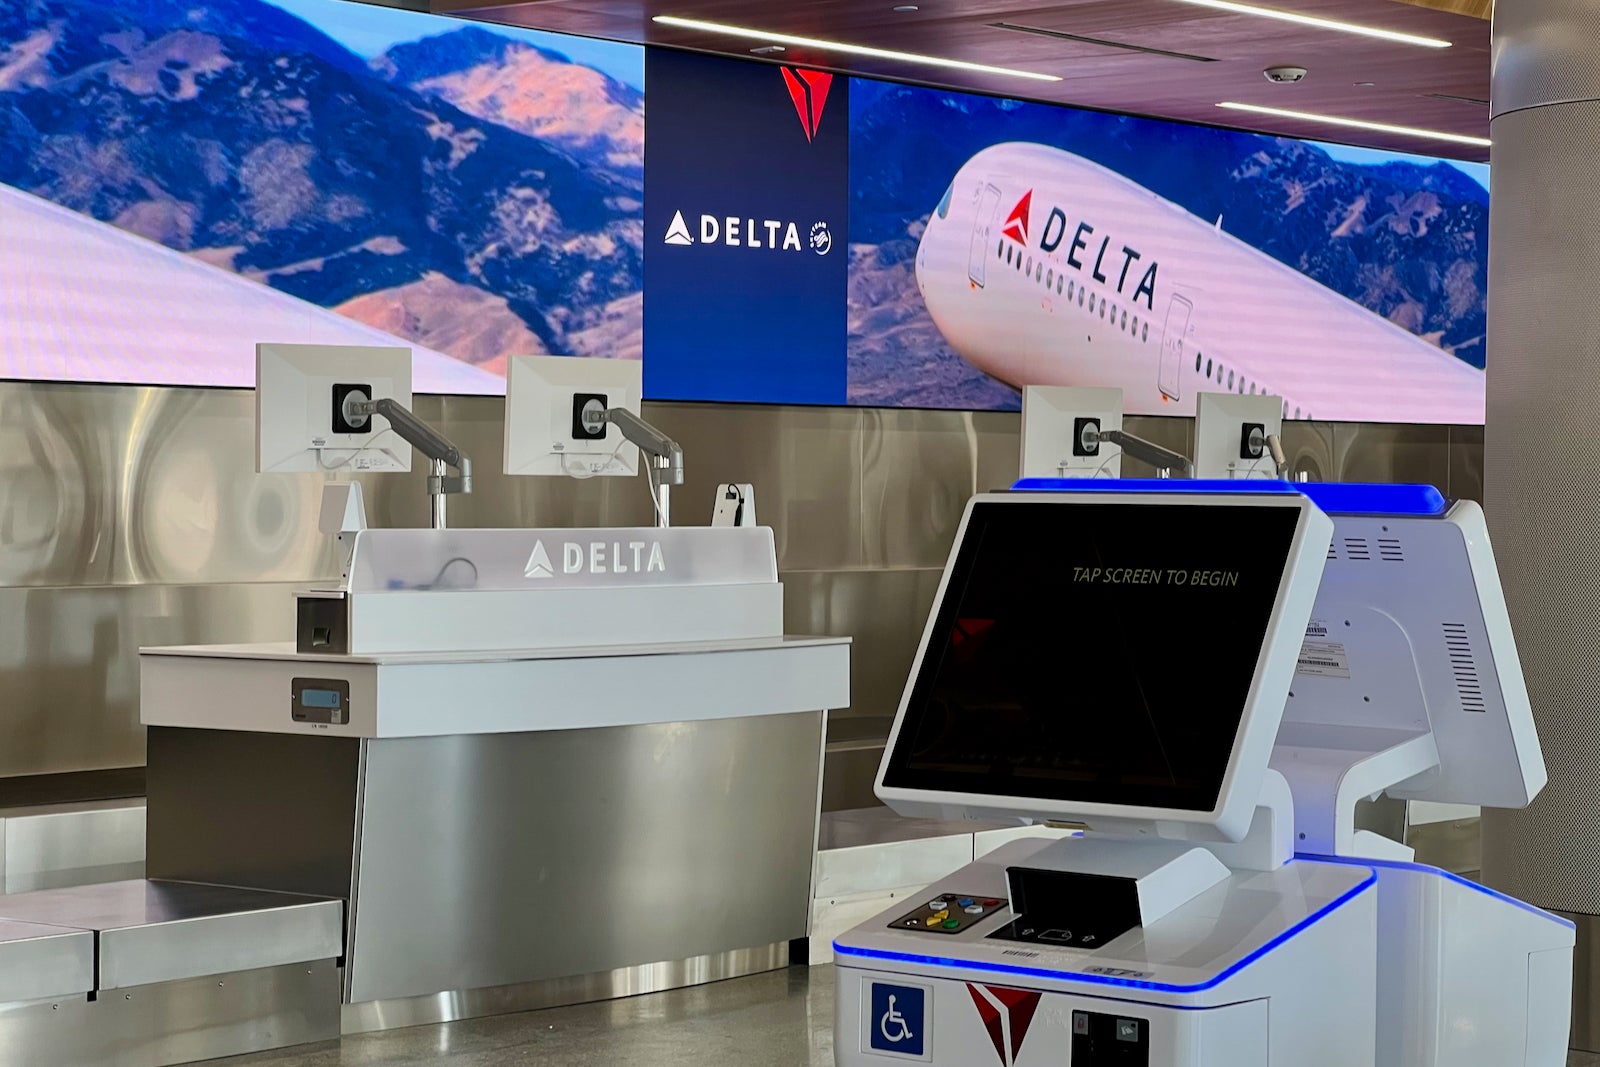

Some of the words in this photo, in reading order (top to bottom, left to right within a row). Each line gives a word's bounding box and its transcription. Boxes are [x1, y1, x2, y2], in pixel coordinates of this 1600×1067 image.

[700, 214, 802, 252] DELTA
[1039, 206, 1158, 312] DELTA
[563, 541, 666, 574] DELTA
[1073, 567, 1101, 583] TAP
[1102, 567, 1162, 585] SCREEN
[1166, 569, 1188, 586] TO
[1190, 570, 1239, 587] BEGIN
[331, 693, 337, 705] 0
